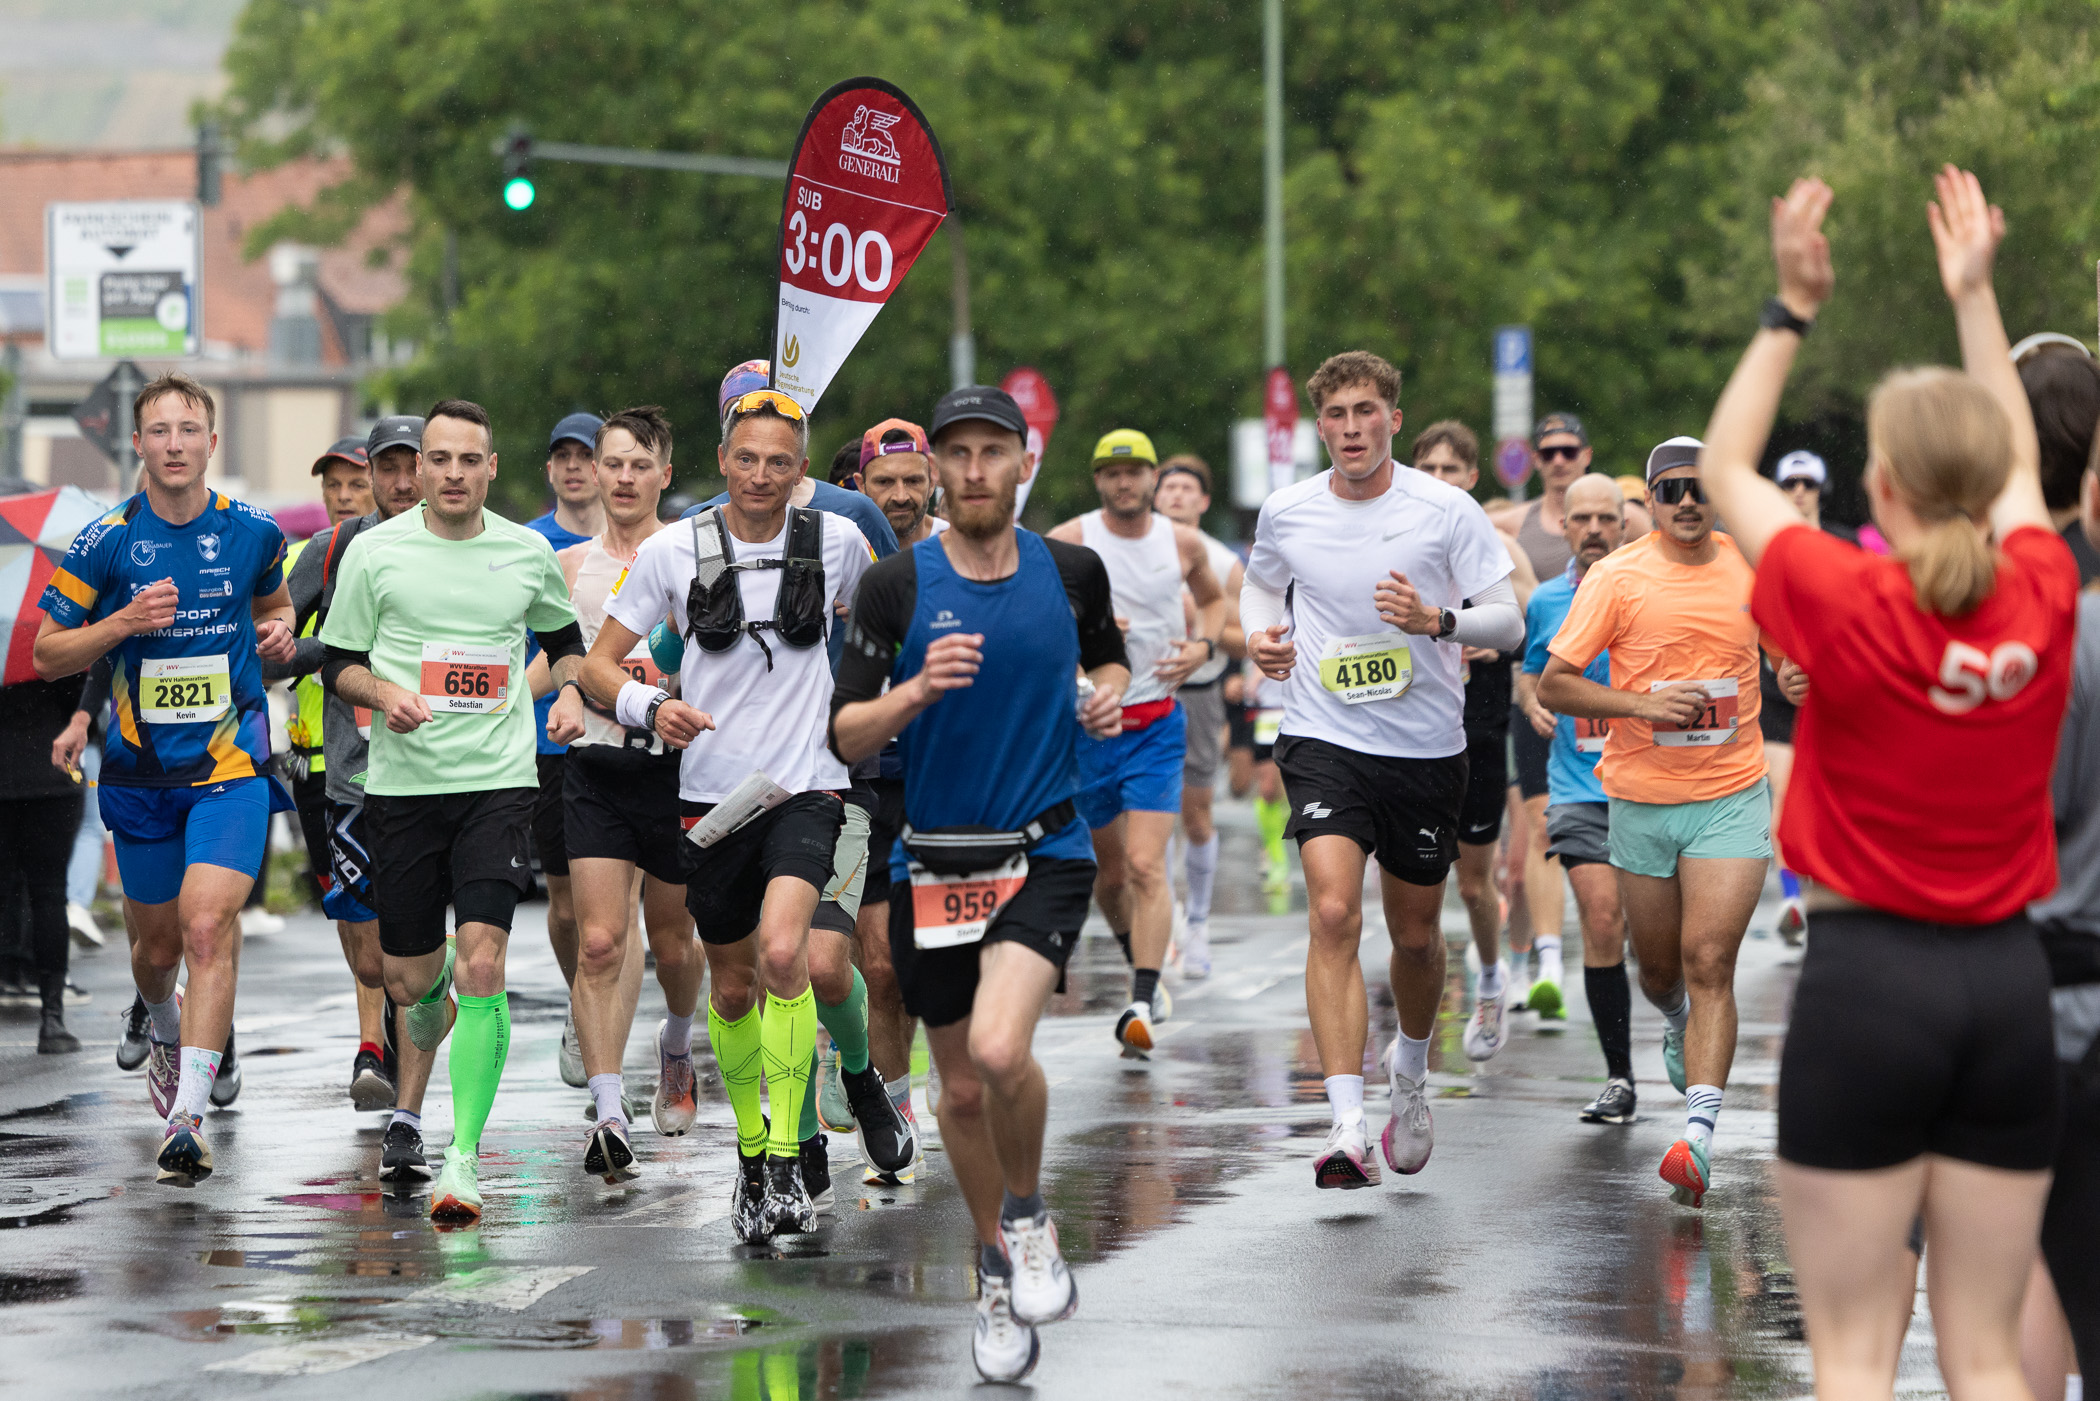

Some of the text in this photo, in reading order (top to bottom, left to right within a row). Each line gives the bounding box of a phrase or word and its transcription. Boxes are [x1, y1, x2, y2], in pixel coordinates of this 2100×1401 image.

[838, 153, 901, 184] GENERALI
[797, 186, 822, 211] SUB
[785, 210, 894, 293] 3:00
[172, 607, 221, 621] PORT
[173, 675, 209, 683] Halbmarathon
[444, 670, 490, 697] 656
[1335, 657, 1397, 688] 4180
[1927, 639, 2039, 716] 50
[154, 681, 215, 708] 2821
[449, 699, 483, 709] Sebastian
[1346, 687, 1393, 700] Sean-Nicolas
[176, 711, 196, 720] Kevin
[1686, 733, 1711, 742] Martin
[944, 890, 998, 923] 959
